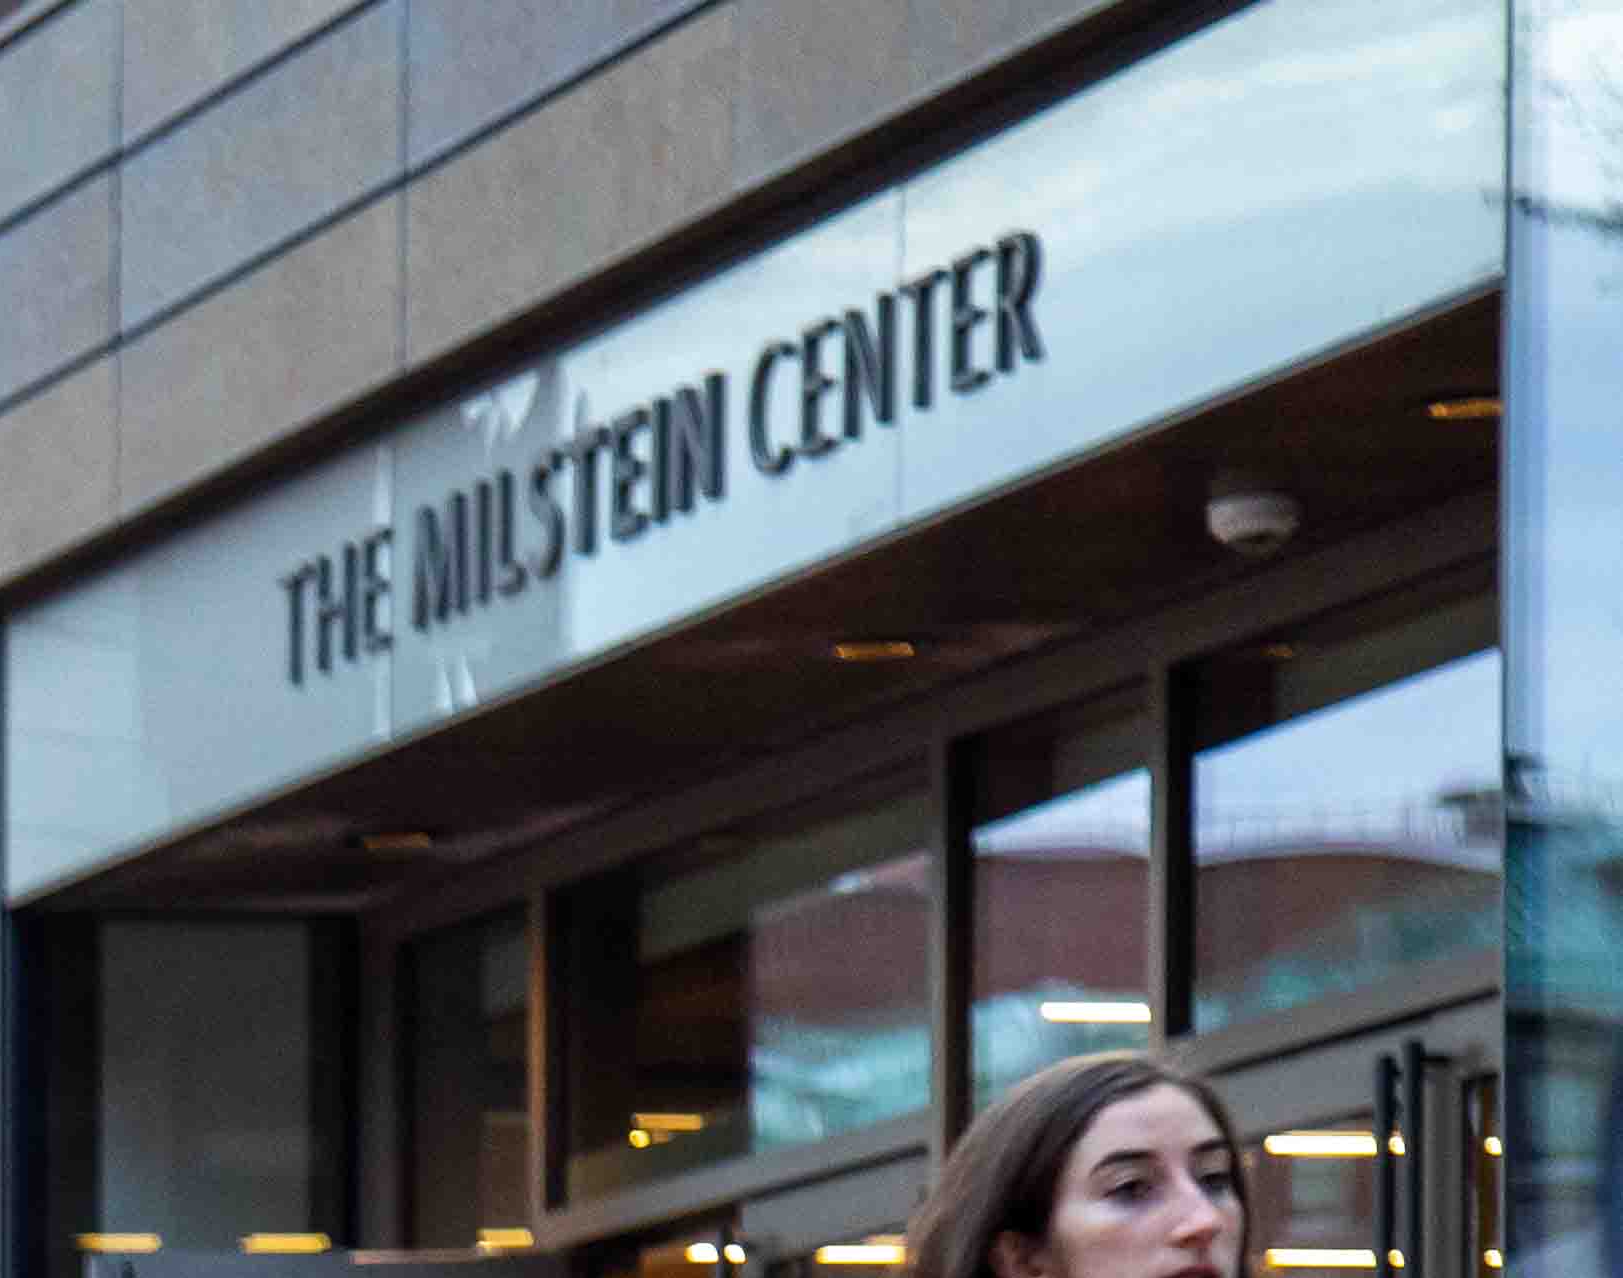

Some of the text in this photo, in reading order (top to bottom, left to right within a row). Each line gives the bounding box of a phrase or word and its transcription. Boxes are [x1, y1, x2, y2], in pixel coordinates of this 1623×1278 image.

[276, 229, 1046, 688] THE MILSTEIN CENTER
